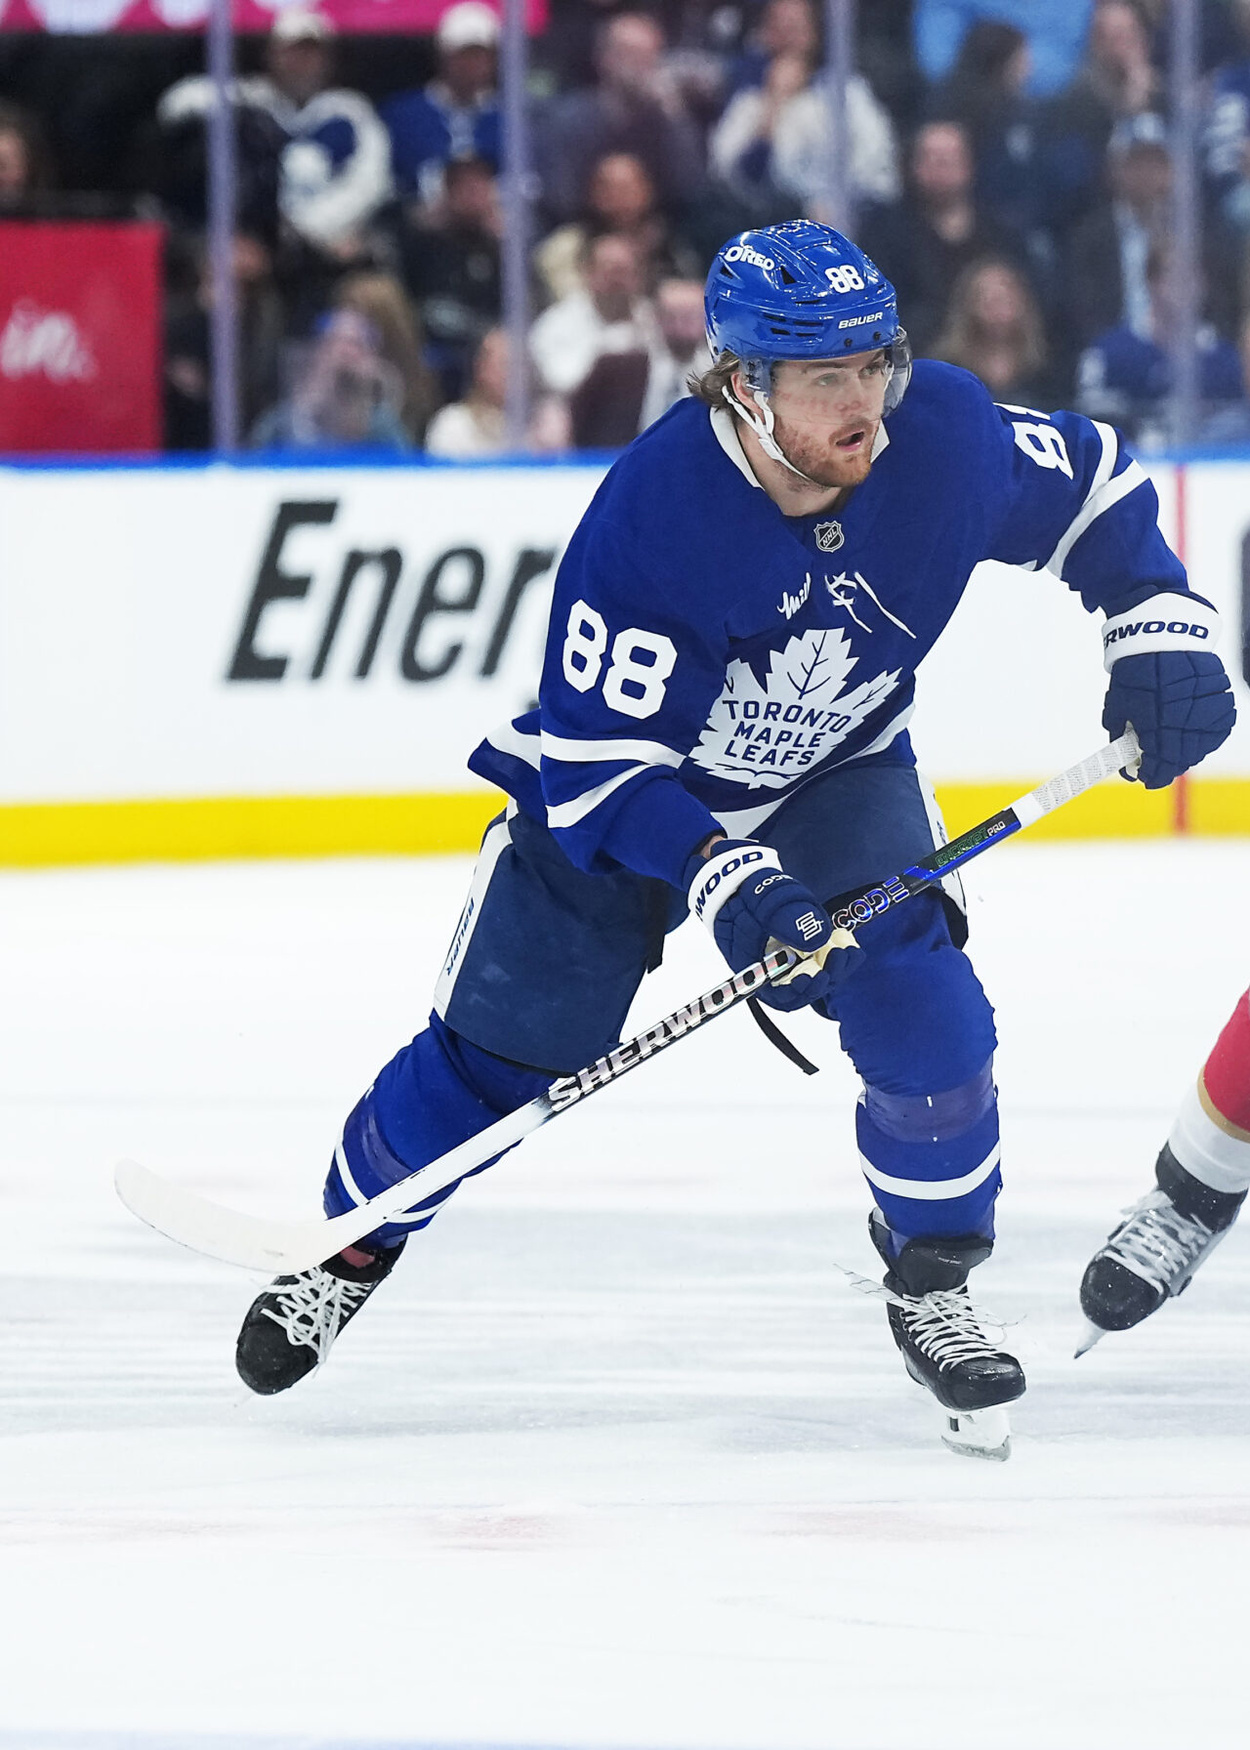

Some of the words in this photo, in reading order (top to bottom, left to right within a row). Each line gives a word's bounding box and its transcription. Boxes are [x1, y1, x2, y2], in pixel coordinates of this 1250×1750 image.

[724, 246, 775, 271] OREO
[824, 264, 865, 294] 88
[838, 311, 883, 330] BAUER
[992, 401, 1074, 481] 8
[225, 500, 556, 682] Ener
[1104, 621, 1209, 649] RWOOD
[562, 599, 678, 720] 88
[722, 700, 852, 733] TORONTO
[734, 721, 826, 749] MAPLE
[724, 743, 815, 767] LEAFS
[987, 821, 1006, 837] PRO
[695, 851, 763, 921] WOOD
[832, 876, 911, 932] CODE
[548, 948, 798, 1112] SHERWOOD
